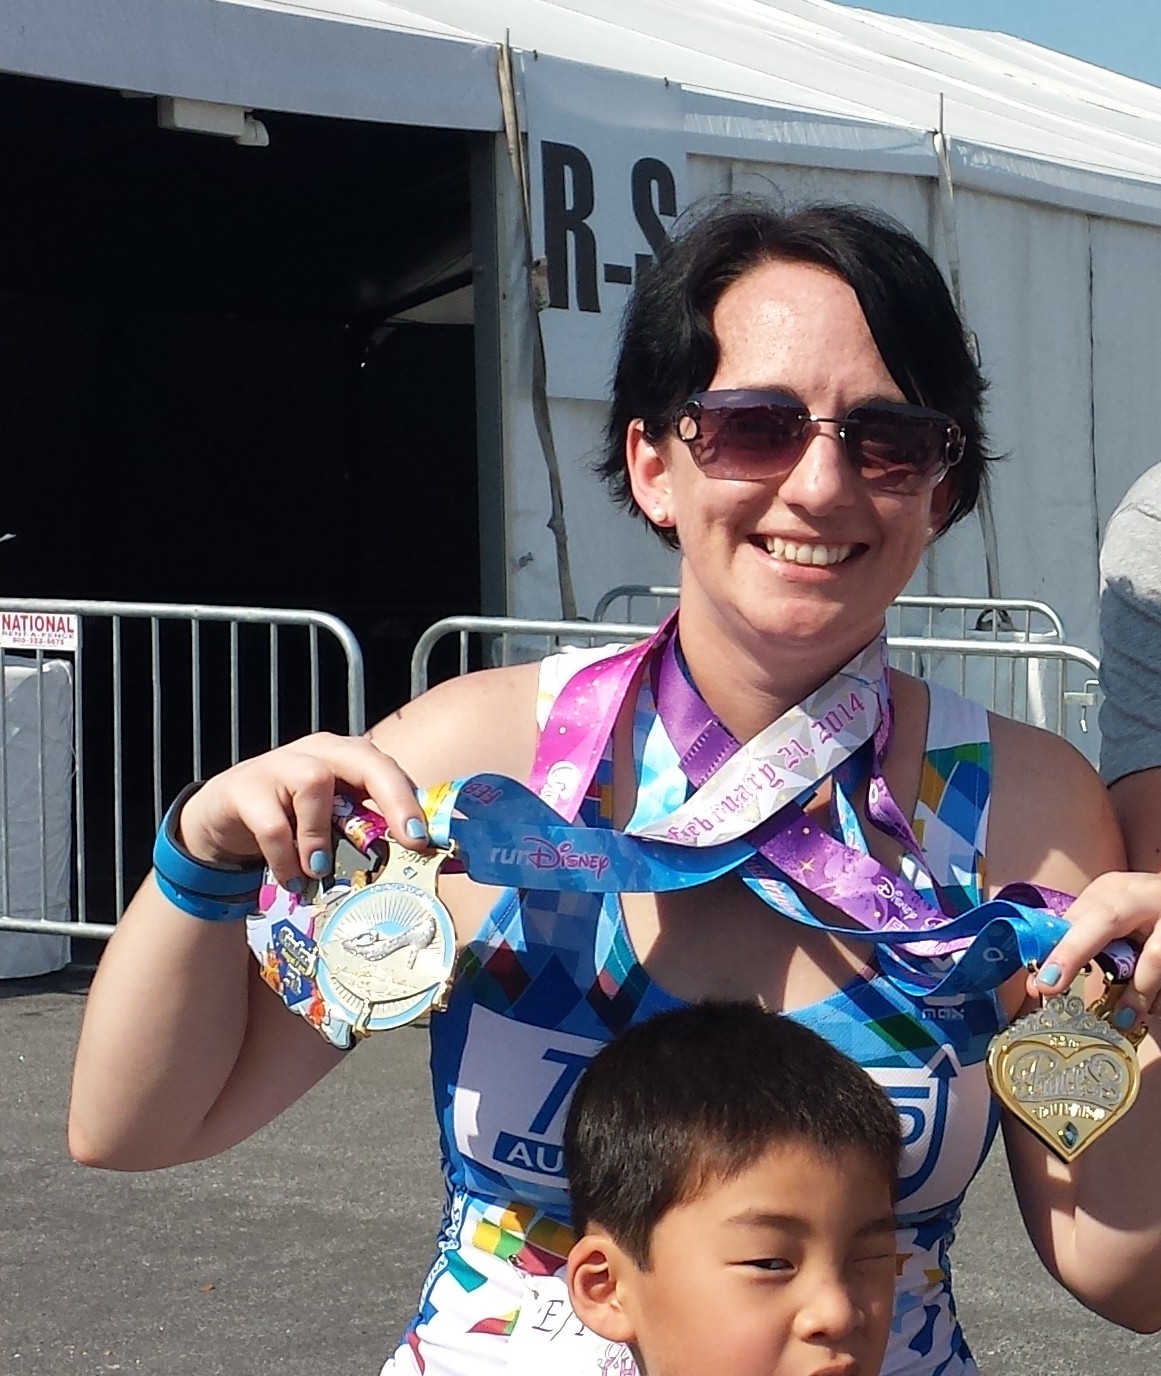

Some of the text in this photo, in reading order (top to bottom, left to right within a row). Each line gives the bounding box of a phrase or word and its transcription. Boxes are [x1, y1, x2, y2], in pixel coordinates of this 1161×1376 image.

[2, 614, 74, 633] NATIONAL
[666, 763, 784, 841] February
[811, 692, 865, 744] 2014
